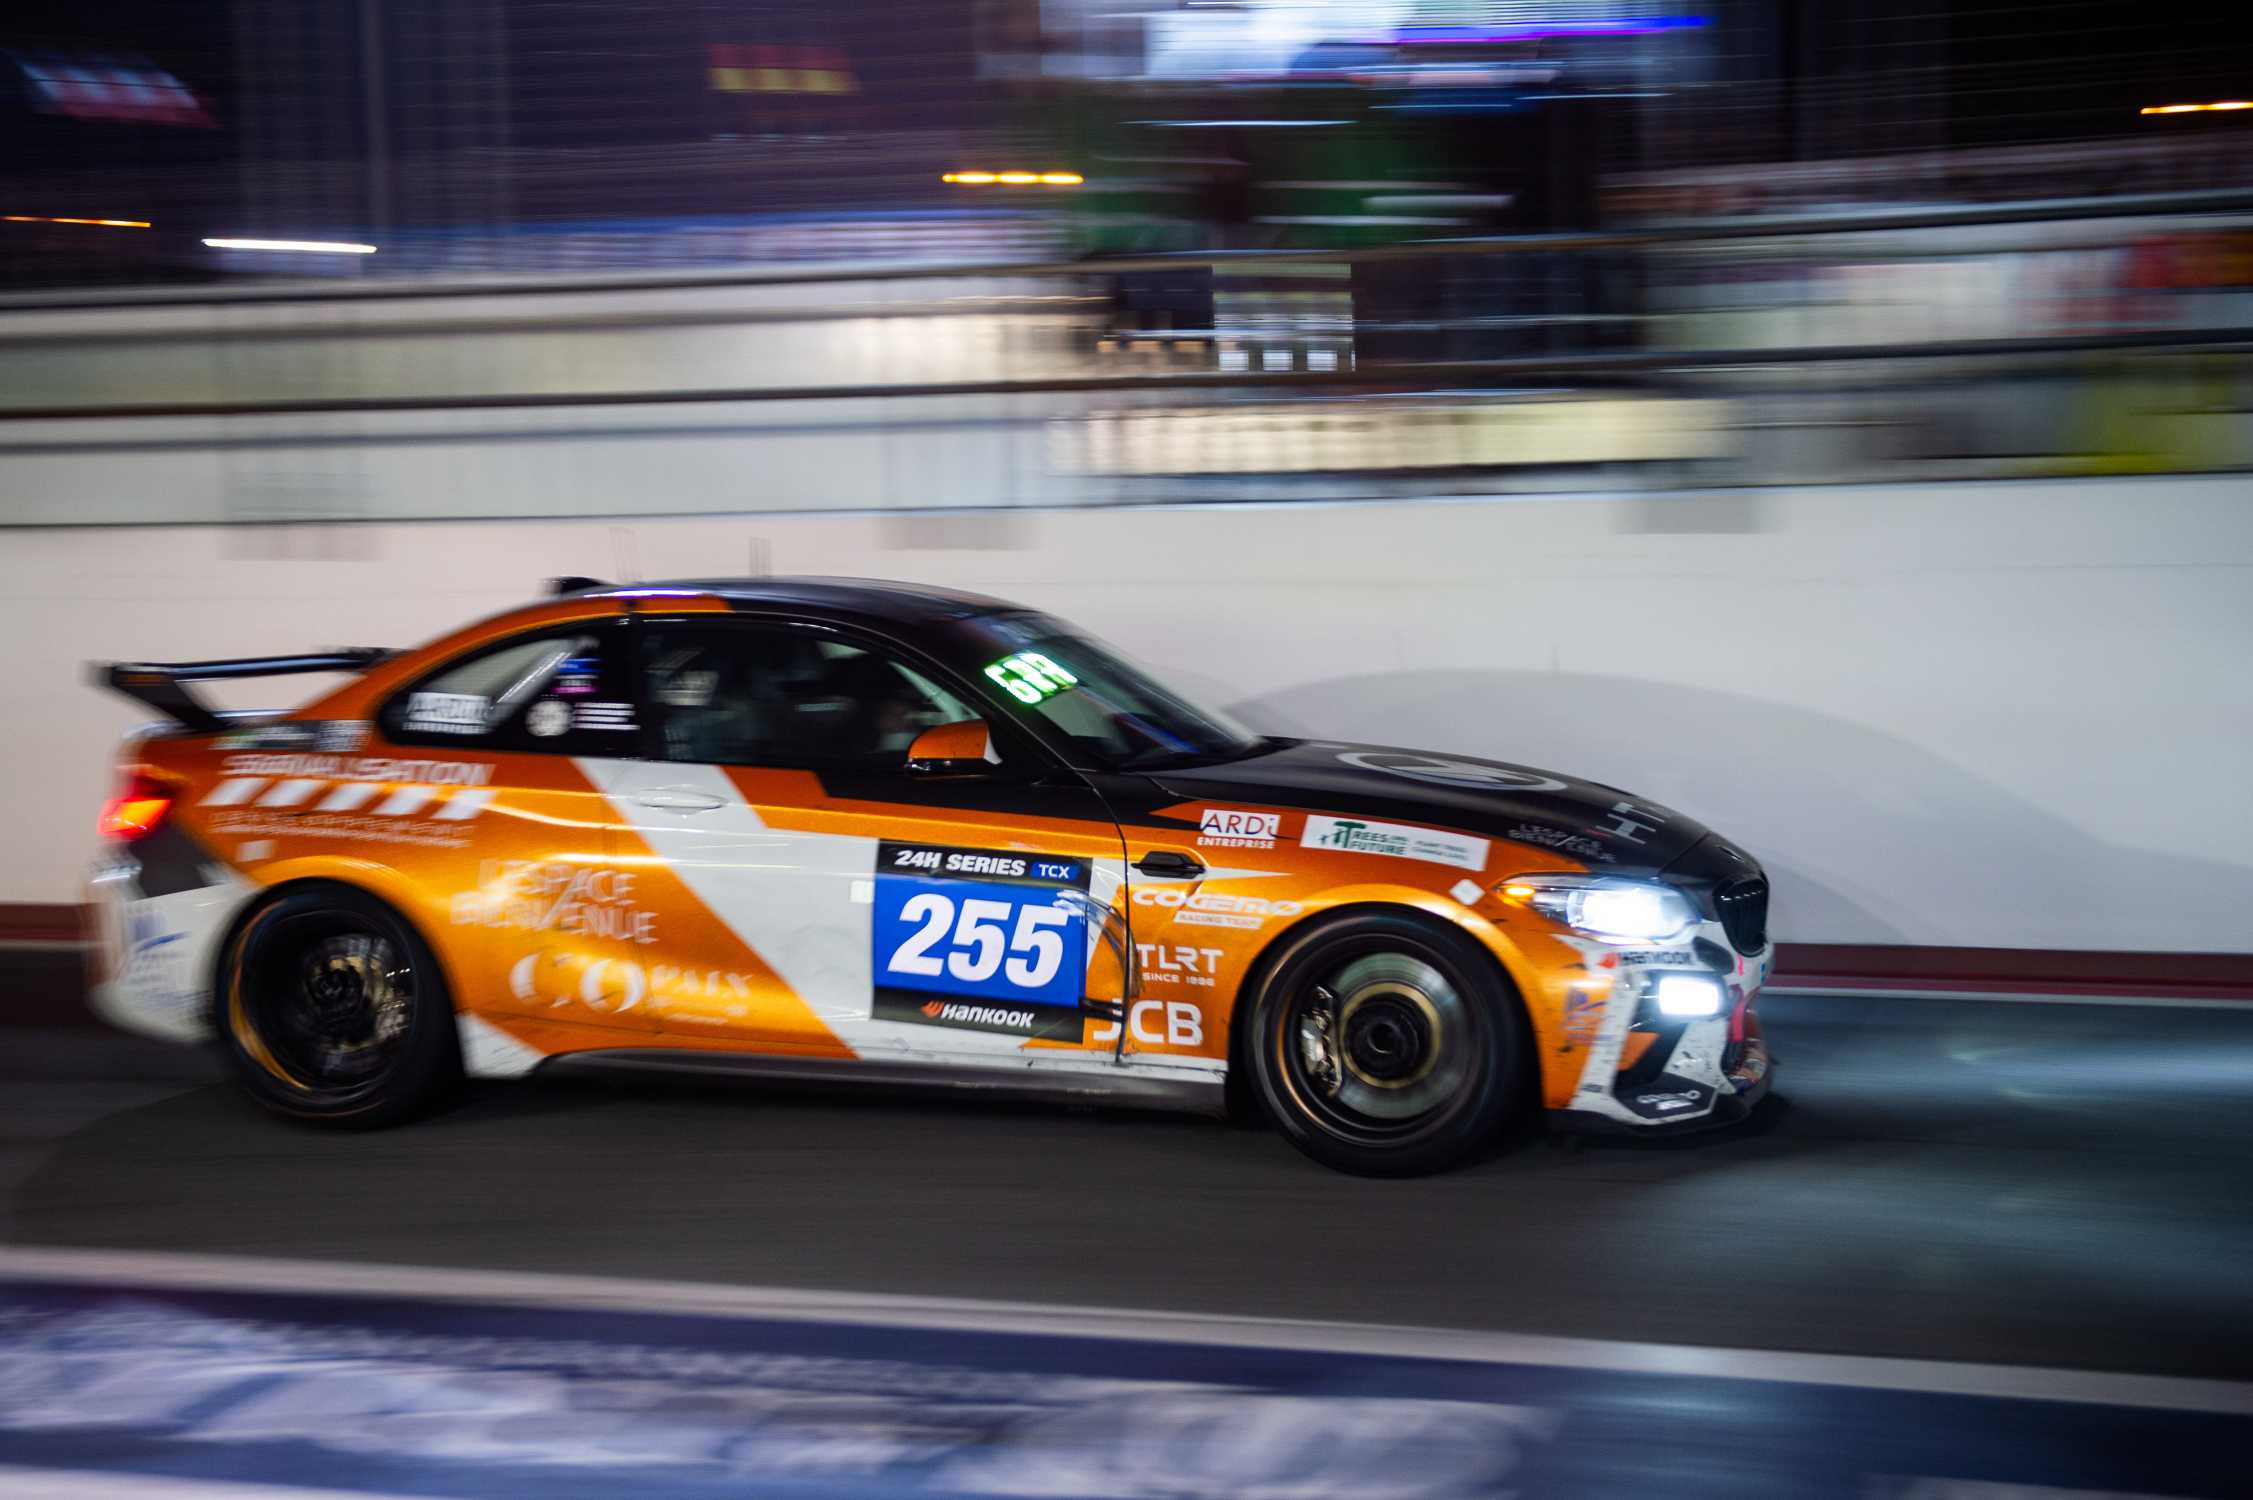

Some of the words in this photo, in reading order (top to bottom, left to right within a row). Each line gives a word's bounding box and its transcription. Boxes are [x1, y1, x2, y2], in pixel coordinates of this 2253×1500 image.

[1197, 837, 1276, 849] ENTREPRISE
[1351, 842, 1404, 855] FUTURE
[894, 850, 942, 869] 24H
[945, 853, 1026, 876] SERIES
[1038, 864, 1070, 878] TCX
[887, 893, 1070, 988] 255
[1136, 943, 1224, 974] TLRT
[1141, 972, 1180, 984] SINCE
[1094, 998, 1204, 1047] JCB
